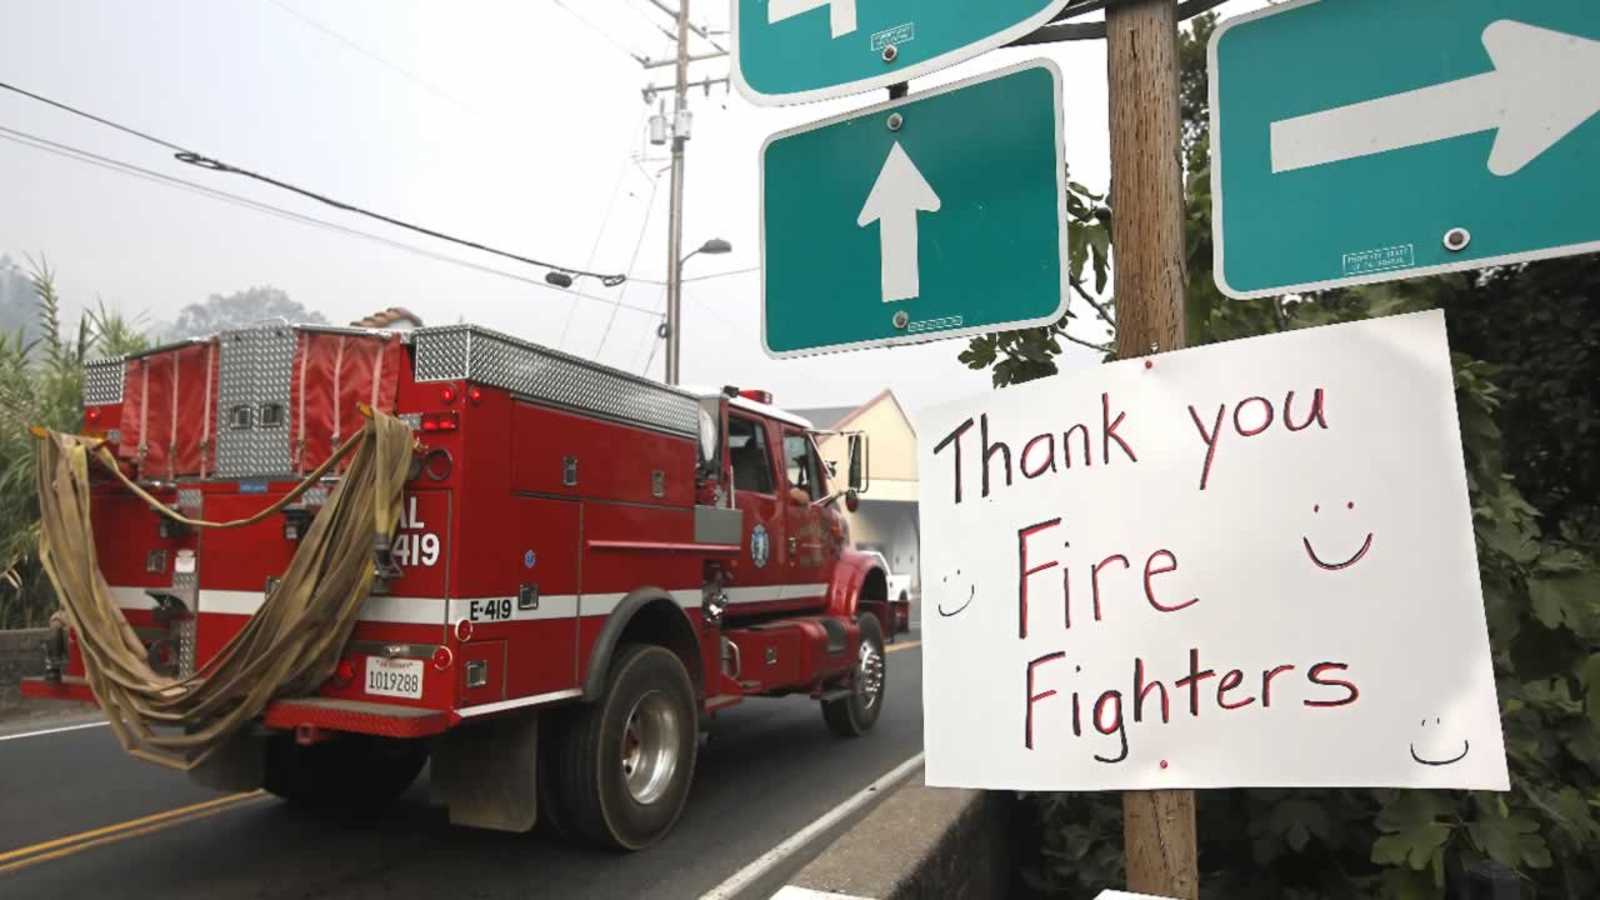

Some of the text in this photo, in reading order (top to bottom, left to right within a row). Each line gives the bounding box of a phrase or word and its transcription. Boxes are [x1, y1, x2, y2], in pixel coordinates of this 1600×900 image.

[933, 388, 1329, 504] Thank you
[392, 533, 440, 566] 419
[1018, 517, 1200, 640] Fire
[470, 600, 512, 621] E-419
[368, 670, 419, 693] 1019288
[1024, 648, 1360, 763] Fighters
